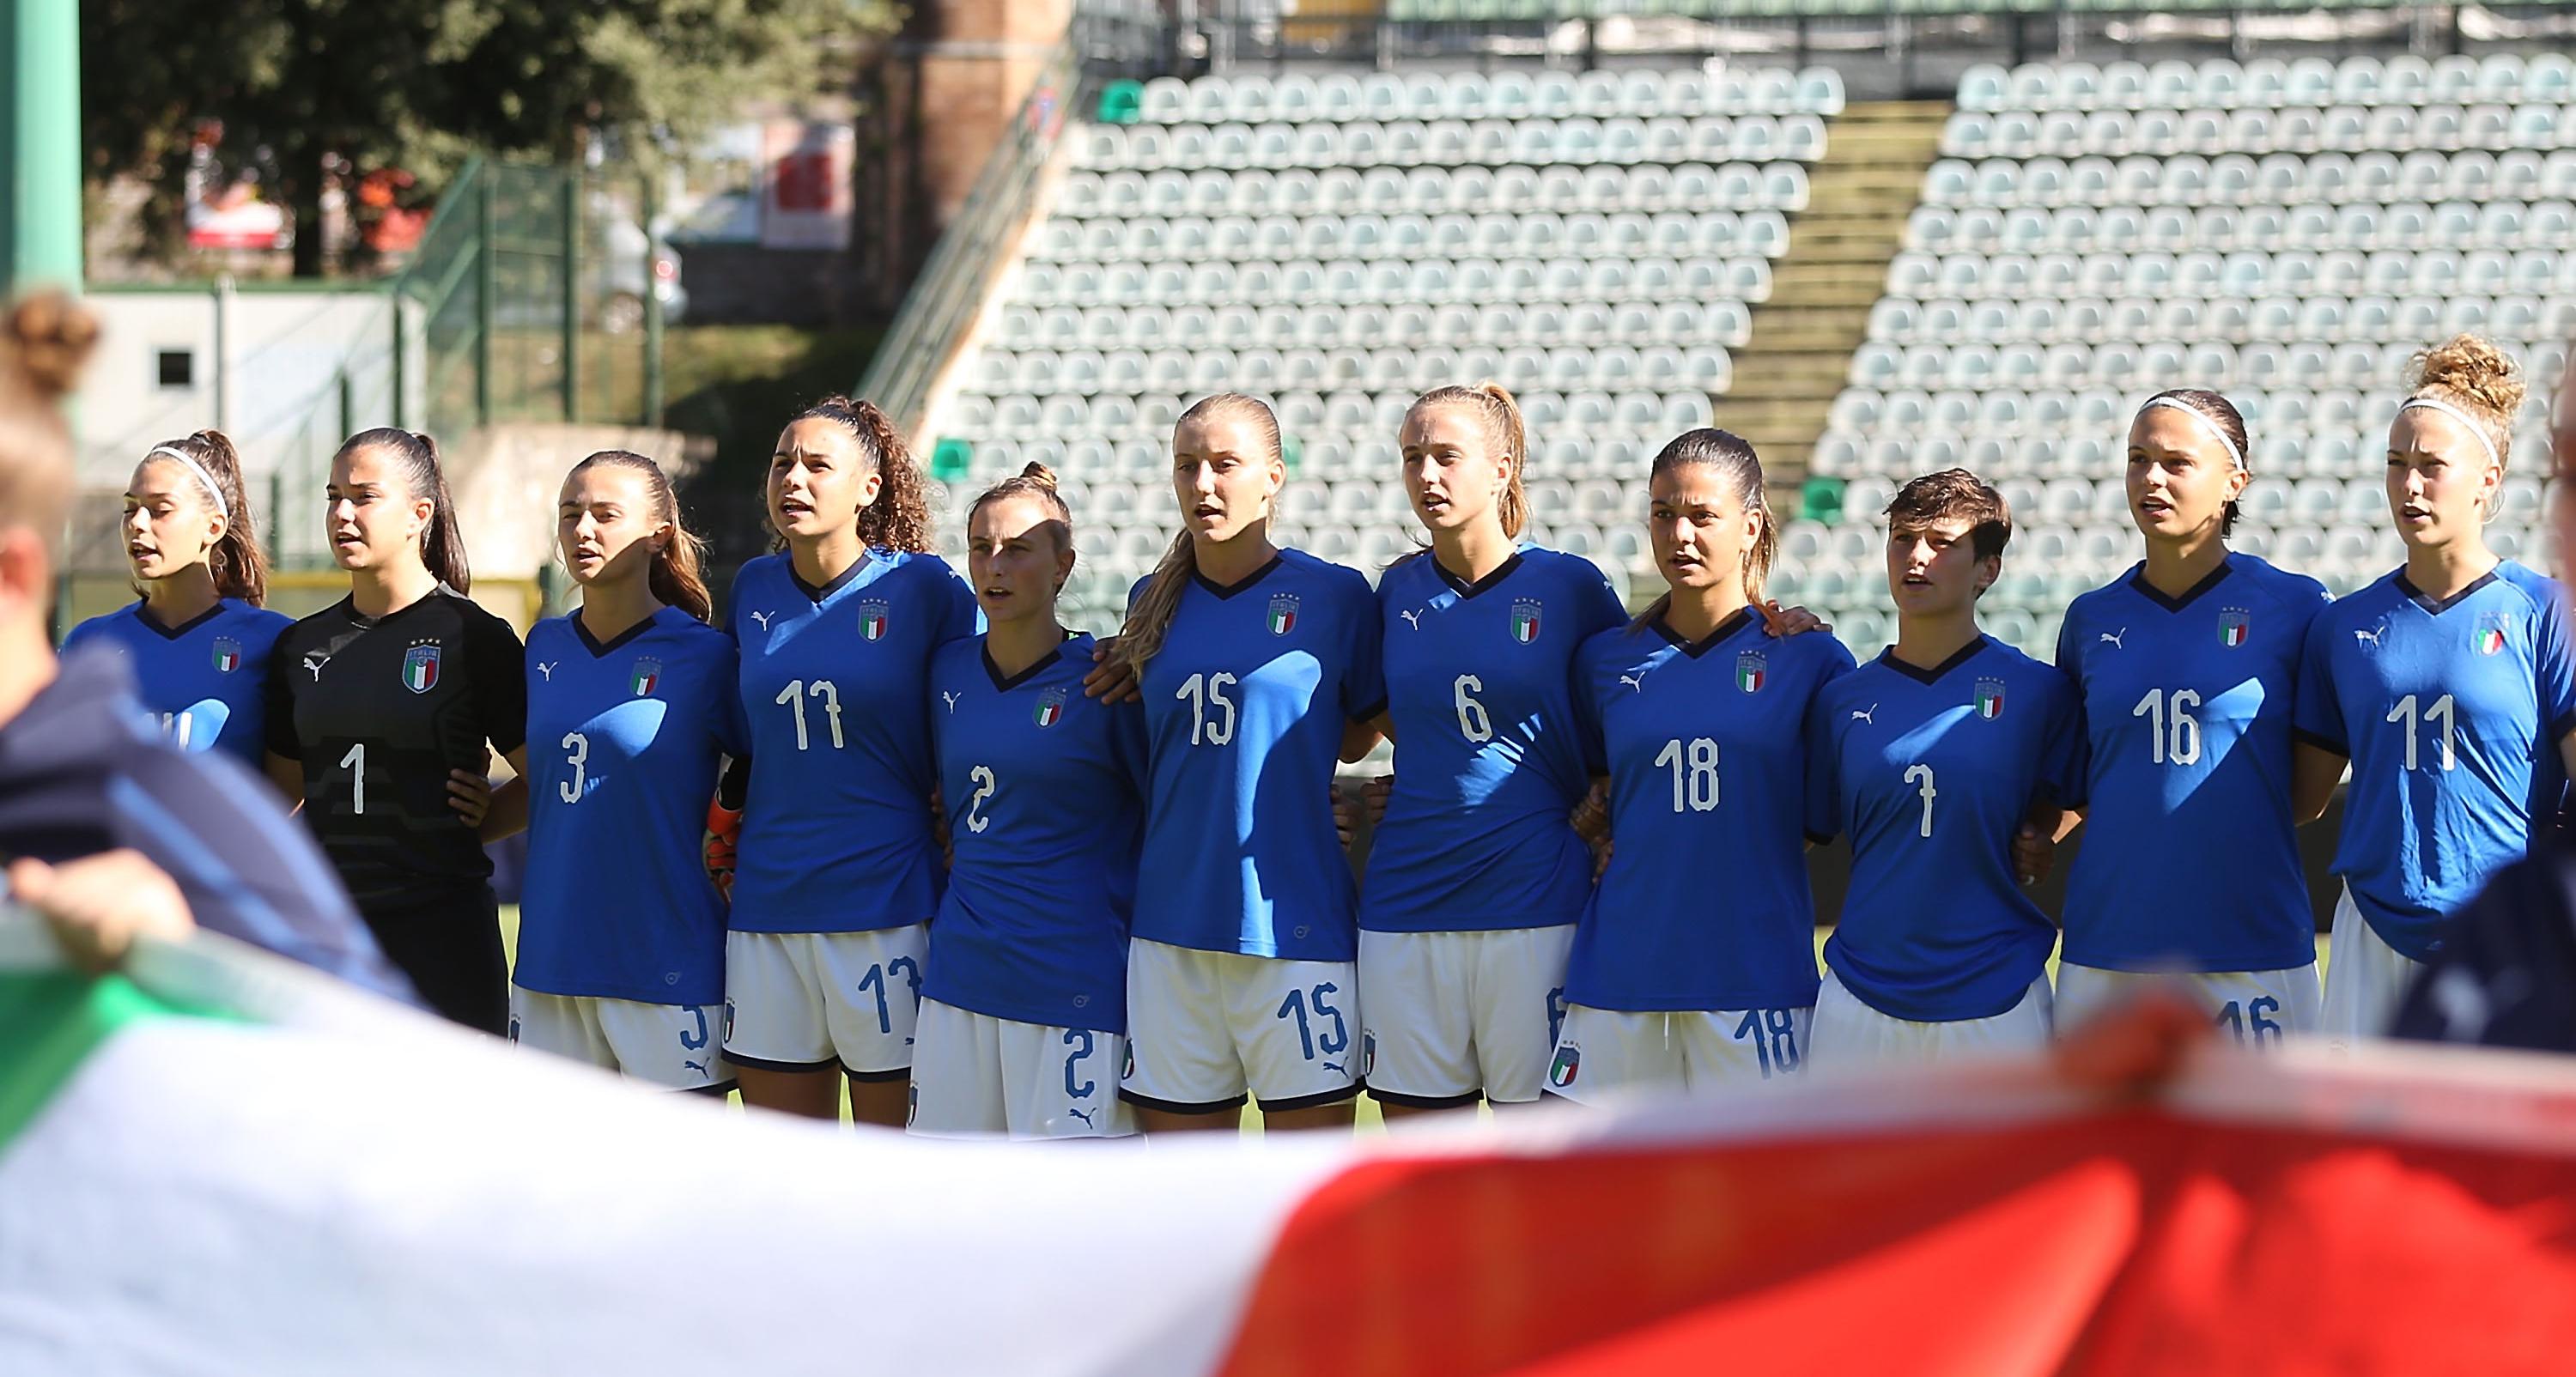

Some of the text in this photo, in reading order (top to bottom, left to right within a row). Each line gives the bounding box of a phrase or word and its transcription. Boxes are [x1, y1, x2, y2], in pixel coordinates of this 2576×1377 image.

[410, 650, 437, 658] ITALIA
[776, 680, 843, 749] 17
[1177, 672, 1236, 745] 15
[1455, 675, 1492, 742] 6
[2133, 688, 2201, 765] 16
[2387, 694, 2455, 771] 11
[340, 743, 366, 814] 1
[560, 732, 589, 804] 3
[967, 765, 995, 833] 2
[1655, 737, 1720, 812] 18
[1905, 764, 1935, 837] 7
[859, 955, 921, 1034] 17
[1278, 981, 1349, 1060] 15
[1064, 1029, 1094, 1098] 2
[1735, 1008, 1800, 1079] 18
